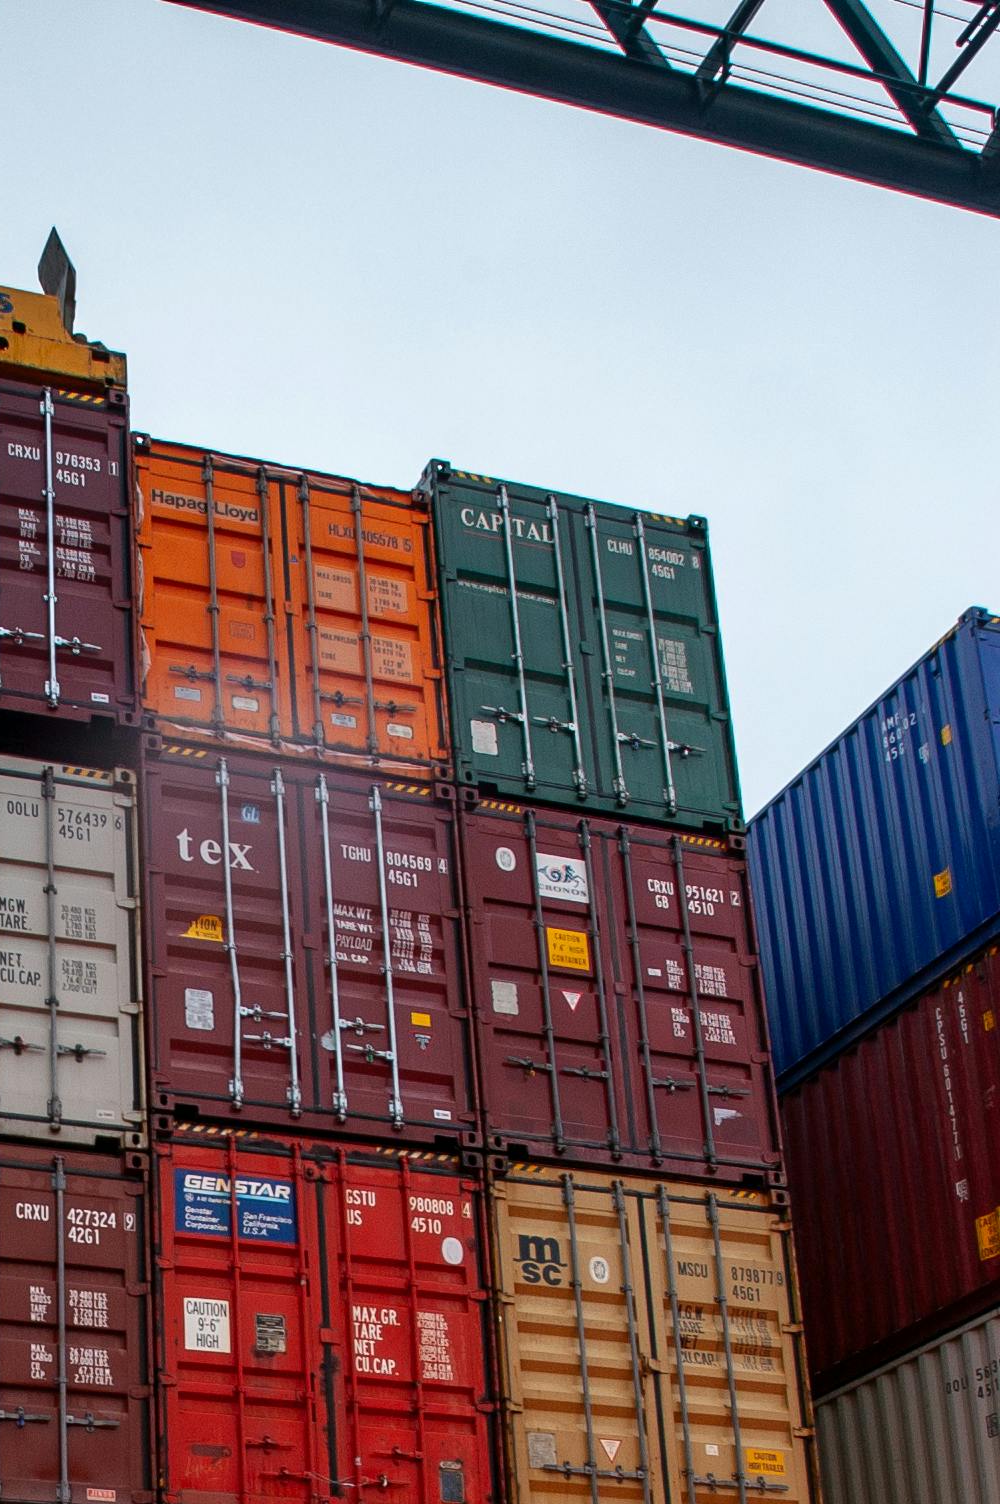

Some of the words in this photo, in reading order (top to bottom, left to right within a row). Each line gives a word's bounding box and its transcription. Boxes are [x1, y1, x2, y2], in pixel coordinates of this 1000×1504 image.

[8, 443, 40, 461] CRXU
[56, 452, 100, 472] 976353
[56, 469, 85, 487] 45G1
[151, 488, 258, 522] HapagLloyd
[607, 539, 632, 556] CLHU
[648, 548, 684, 566] 854002
[652, 564, 675, 580] 45G1
[7, 800, 39, 818] OOLU
[57, 808, 107, 828] 576439
[115, 815, 122, 829] 6
[59, 825, 90, 842] 45G1
[341, 844, 371, 862] TGHU
[387, 852, 432, 871] 804569
[388, 870, 418, 888] 45G1
[648, 878, 674, 895] CRXU
[686, 885, 724, 903] 951621
[655, 895, 669, 909] GB
[688, 901, 715, 916] 4510
[336, 933, 372, 951] PAYLOAD
[184, 1174, 291, 1199] GENSTAR
[346, 1189, 376, 1207] GSTU
[409, 1196, 454, 1216] 980808
[16, 1203, 49, 1221] CRXU
[67, 1208, 116, 1229] 427324
[347, 1210, 362, 1225] US
[411, 1217, 442, 1235] 4510
[68, 1229, 99, 1244] 42G1
[677, 1261, 708, 1278] MSCU
[731, 1266, 773, 1285] 879877
[776, 1272, 783, 1285] 9
[30, 1294, 52, 1304] GROSS
[732, 1285, 761, 1302] 45G1
[31, 1303, 47, 1313] TARE
[186, 1301, 227, 1317] CAUTION
[353, 1322, 383, 1341] TARE
[196, 1334, 219, 1349] HIGH
[354, 1339, 375, 1356] NET
[31, 1352, 52, 1362] CARGO
